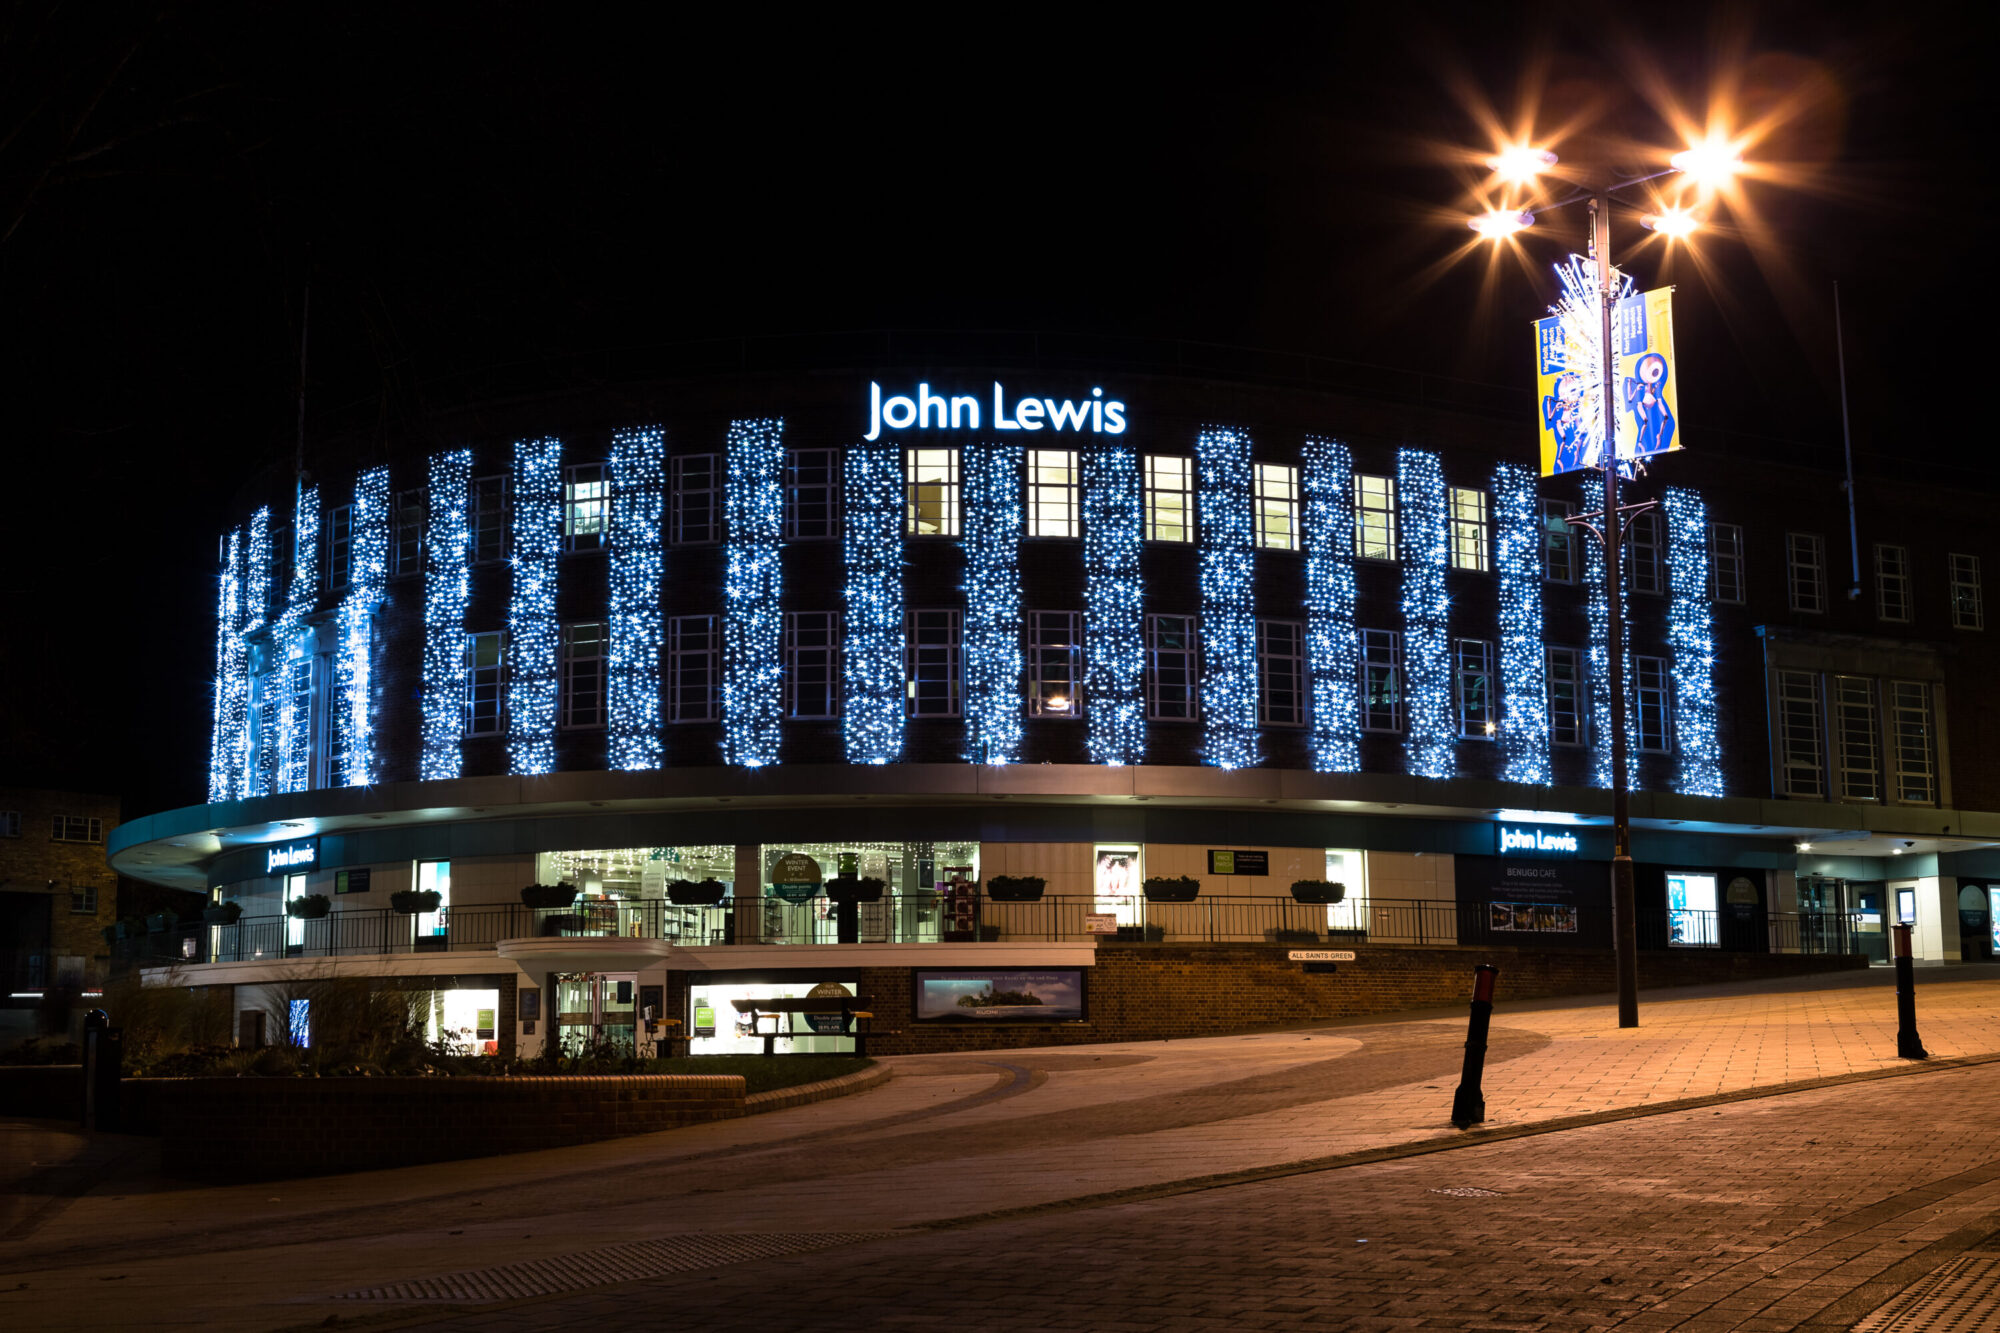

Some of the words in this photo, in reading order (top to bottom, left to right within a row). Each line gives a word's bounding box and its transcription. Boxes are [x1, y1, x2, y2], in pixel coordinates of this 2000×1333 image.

[863, 381, 980, 441] John
[994, 381, 1126, 434] Lewis
[1500, 827, 1536, 853] John
[1536, 829, 1578, 852] Lewis
[267, 848, 289, 873] John
[289, 843, 315, 865] Lewis
[1506, 867, 1538, 877] BENUGO
